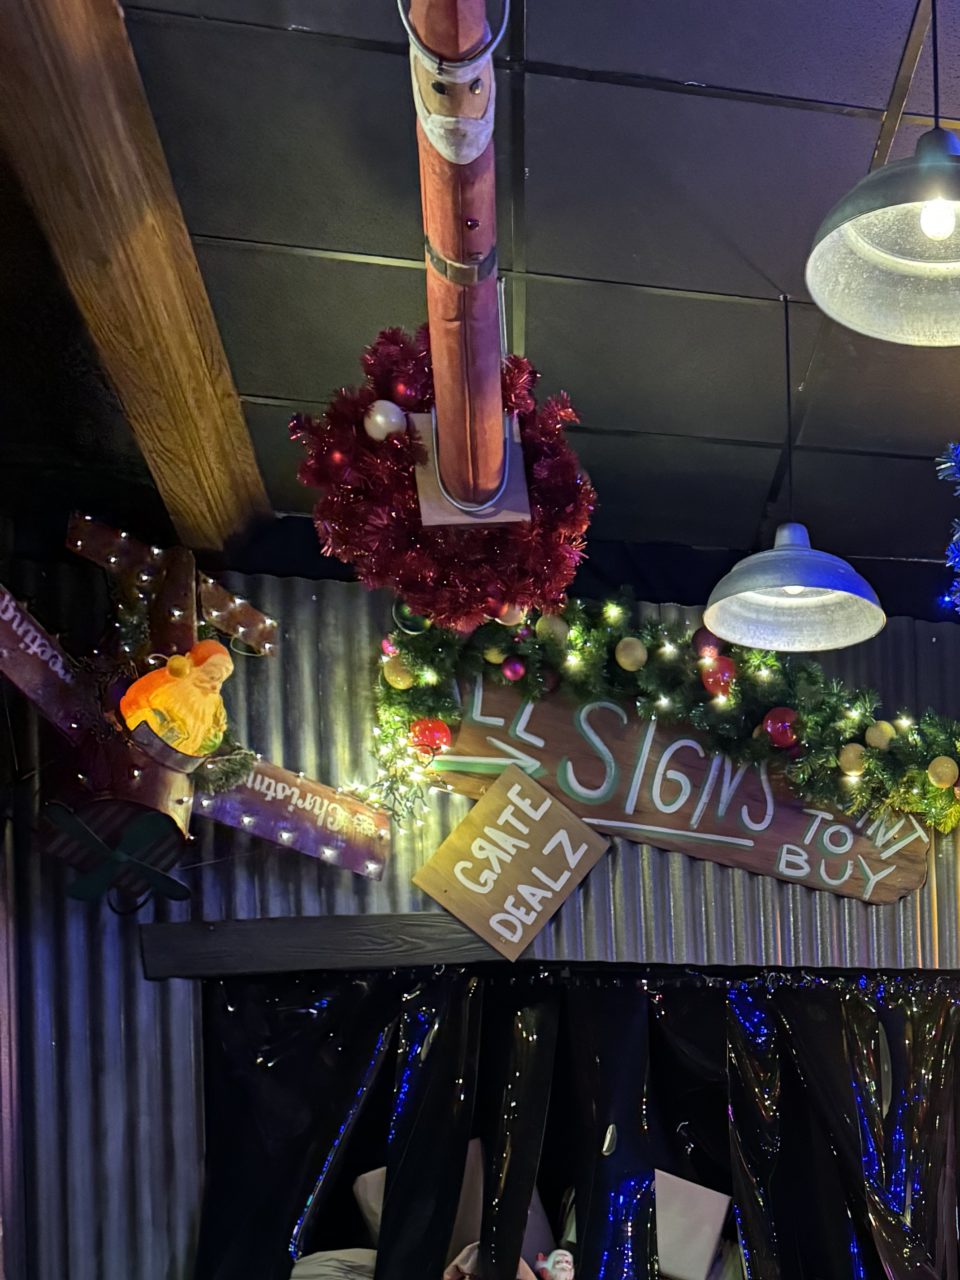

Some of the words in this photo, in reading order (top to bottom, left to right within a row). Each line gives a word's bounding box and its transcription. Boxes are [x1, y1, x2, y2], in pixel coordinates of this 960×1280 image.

[452, 669, 546, 748] LL
[564, 700, 775, 832] SIGNS
[778, 843, 897, 901] BUY
[803, 808, 854, 854] TO
[488, 828, 589, 943] DEALZ
